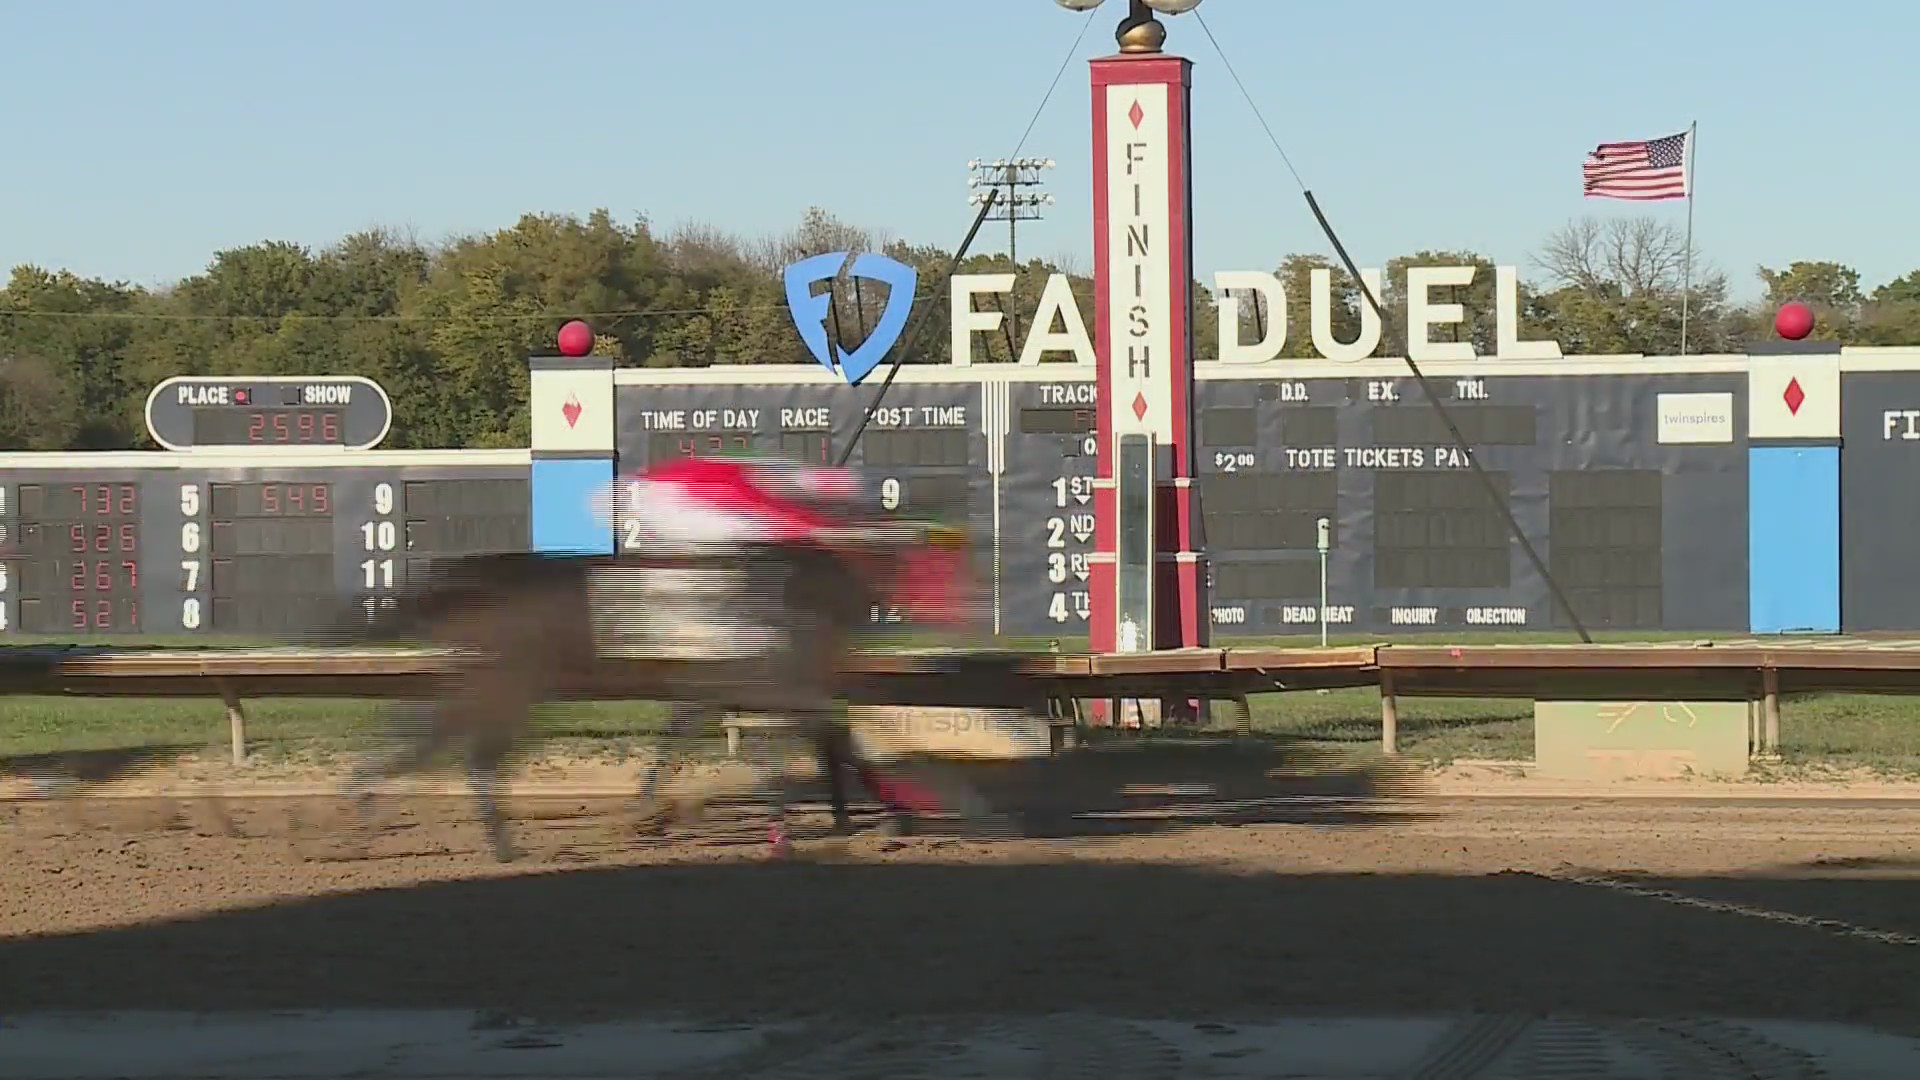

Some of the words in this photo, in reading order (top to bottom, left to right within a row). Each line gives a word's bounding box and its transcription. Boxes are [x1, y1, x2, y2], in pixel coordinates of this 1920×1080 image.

[1127, 142, 1151, 379] FINISH
[949, 265, 1564, 368] FADUEL
[178, 386, 229, 404] PLACE
[305, 385, 351, 404] SHOW
[1281, 382, 1309, 401] D.D.
[1368, 382, 1399, 401] EX.
[1457, 380, 1489, 399] TRI.
[641, 410, 686, 430] TIME
[692, 410, 718, 428] OF
[723, 409, 760, 428] DAY
[781, 407, 830, 427] RACE
[921, 406, 966, 425] TIME
[1664, 411, 1726, 426] twinspires
[1286, 448, 1336, 468] TOTE
[1344, 448, 1424, 468] TICKETS
[181, 485, 199, 516] 5
[263, 485, 328, 513] 549
[375, 483, 393, 515] 9
[881, 478, 900, 510] 9
[181, 522, 199, 553] 6
[360, 521, 396, 551] 10
[623, 518, 641, 548] 2
[181, 560, 199, 592] 7
[360, 559, 393, 589] 11
[182, 598, 199, 629] 8
[1282, 606, 1317, 623] DEAD
[1391, 607, 1438, 625] INQUIRY
[1466, 608, 1526, 625] OBJECTION
